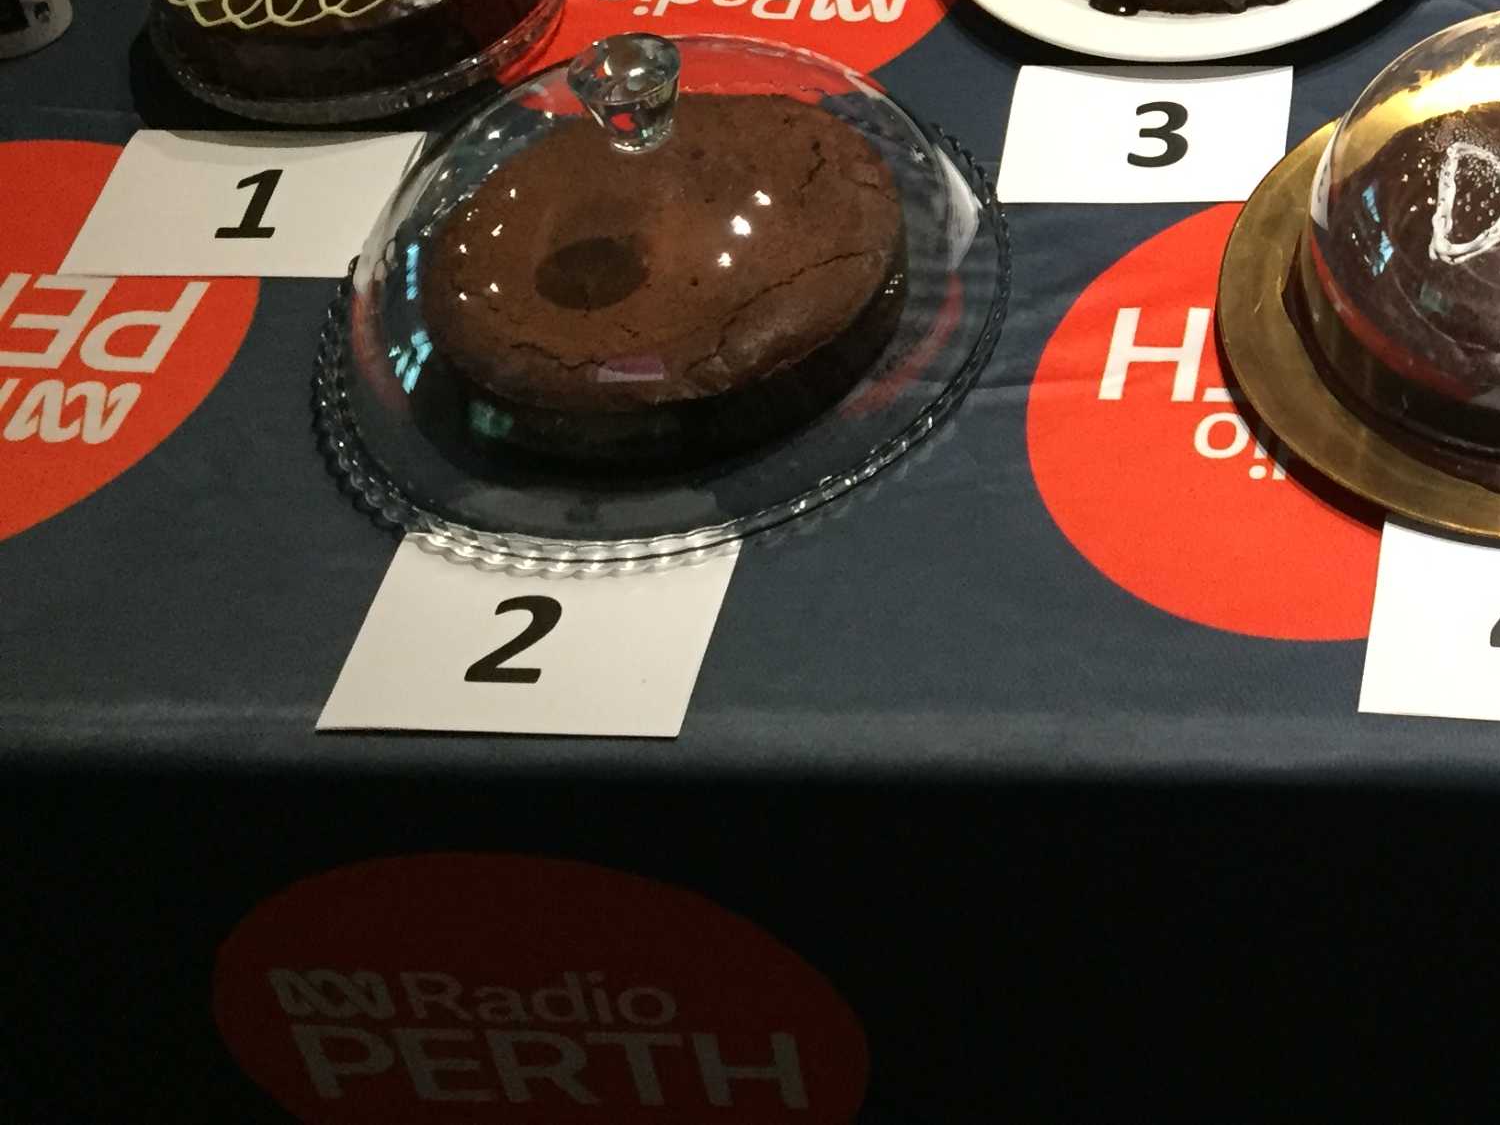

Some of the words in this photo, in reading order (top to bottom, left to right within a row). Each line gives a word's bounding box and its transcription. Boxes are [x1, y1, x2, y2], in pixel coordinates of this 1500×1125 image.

[1126, 101, 1190, 168] 3
[214, 168, 284, 239] 1
[463, 594, 563, 685] 2
[402, 970, 679, 1026] Radio
[288, 1024, 810, 1110] PERTH
